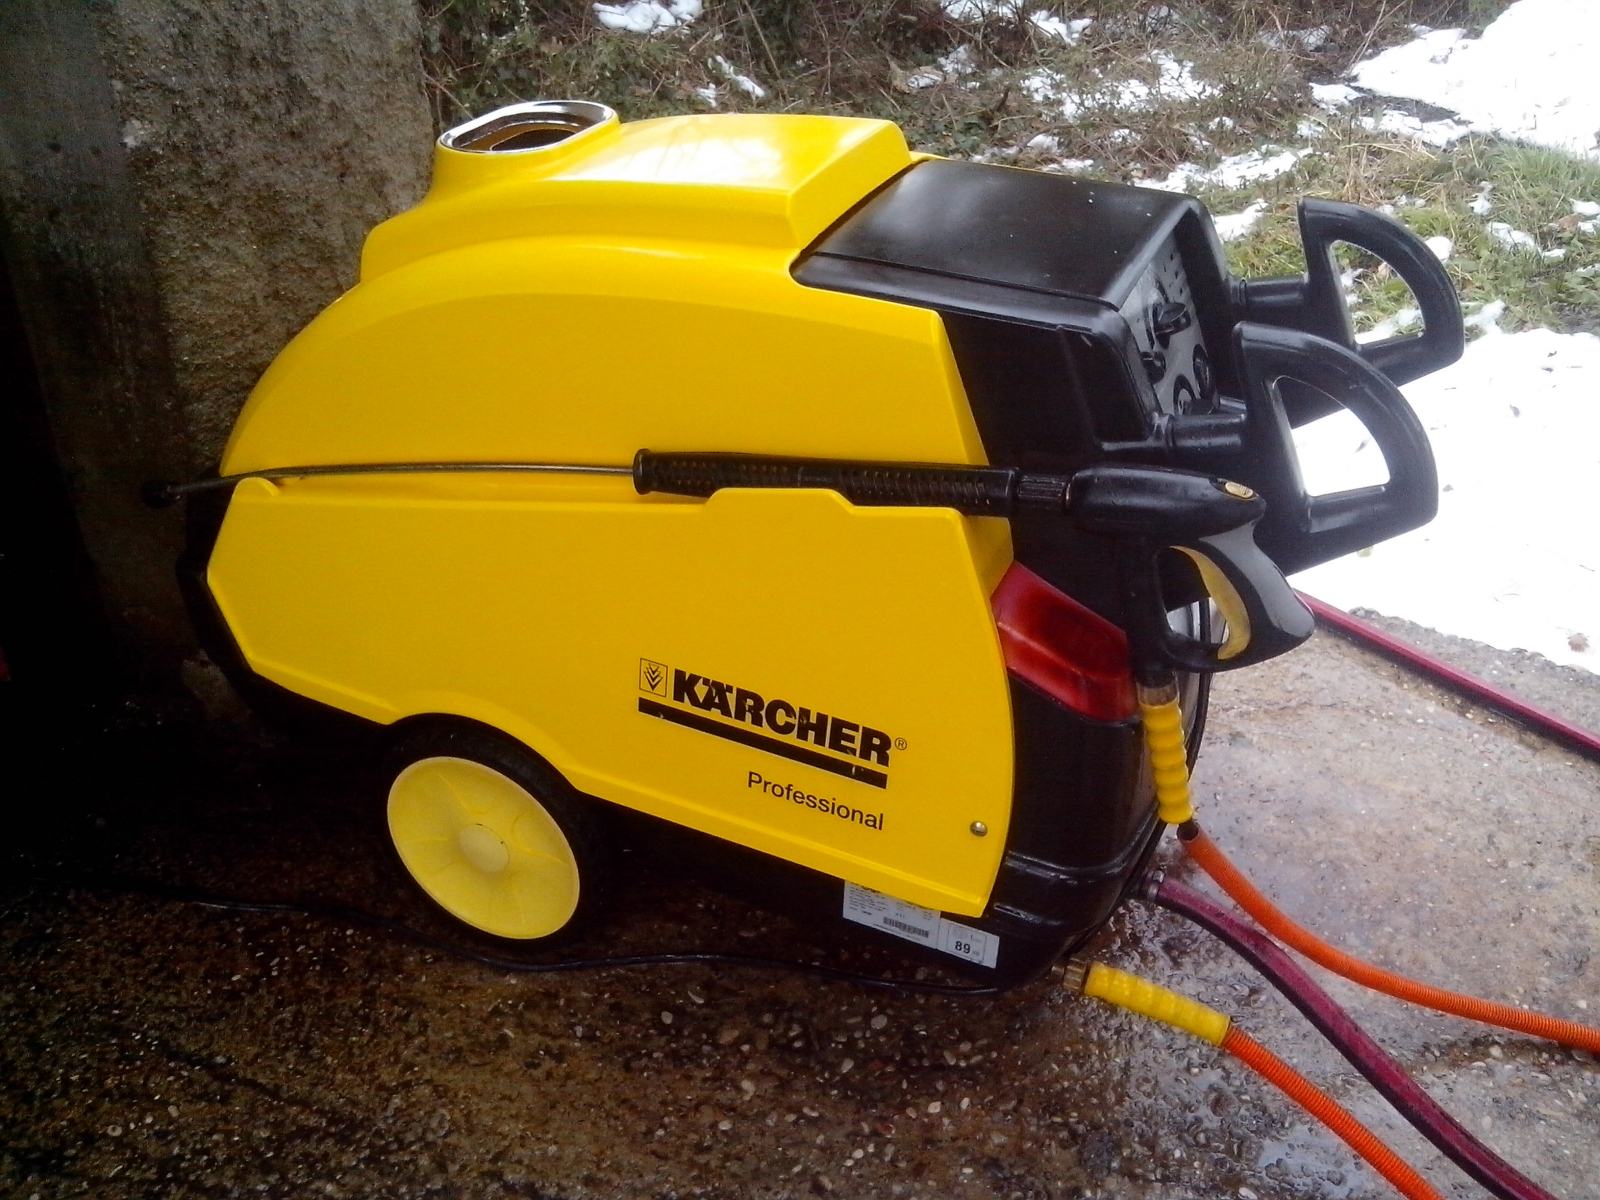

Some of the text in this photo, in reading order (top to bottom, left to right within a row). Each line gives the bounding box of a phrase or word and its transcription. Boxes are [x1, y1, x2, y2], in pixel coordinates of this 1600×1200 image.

[673, 668, 891, 767] KÄRCHER
[747, 771, 884, 830] Professional
[955, 940, 971, 954] 89
